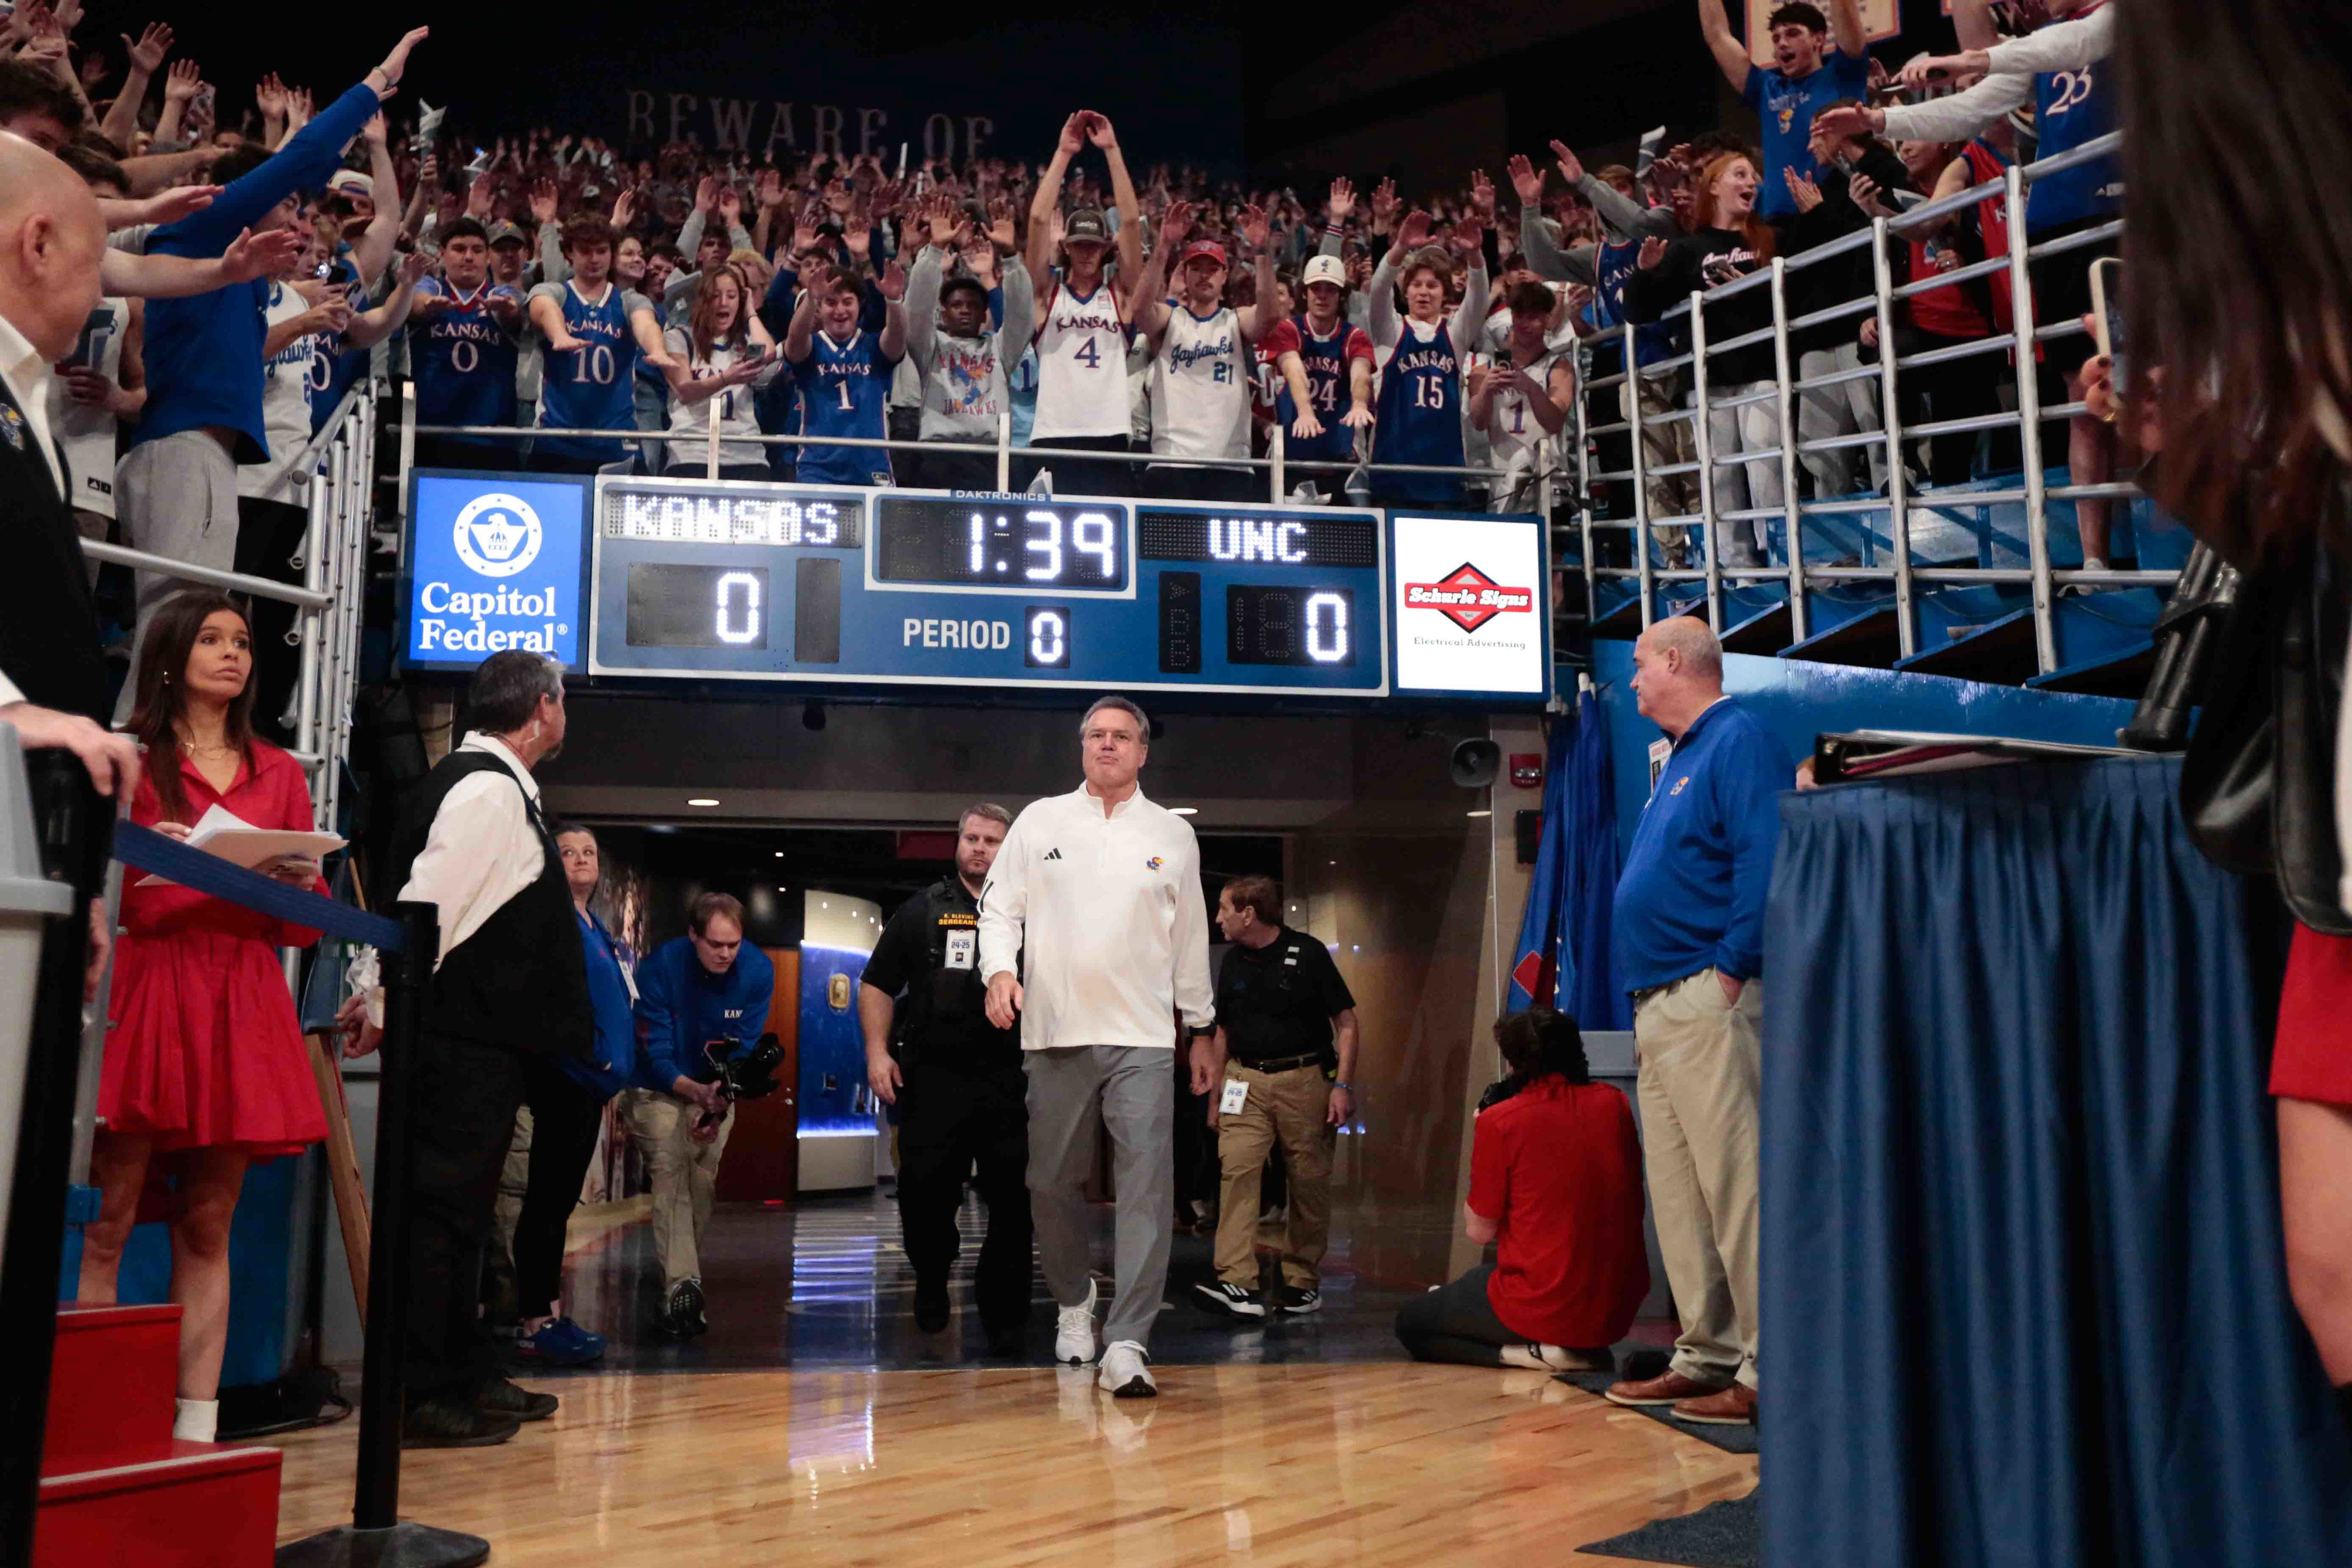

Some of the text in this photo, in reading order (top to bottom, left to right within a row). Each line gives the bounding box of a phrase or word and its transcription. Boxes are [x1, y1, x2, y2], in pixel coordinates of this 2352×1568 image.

[626, 88, 994, 164] BEWARE OF
[430, 322, 501, 346] KANSAS
[1056, 315, 1120, 333] KANSAS
[451, 340, 479, 373] 0
[570, 345, 615, 384] 10
[1074, 336, 1101, 369] 4
[1170, 336, 1234, 374] Jayhawks
[1397, 350, 1454, 374] KANSAS
[835, 379, 855, 410] 1
[1414, 375, 1444, 409] 15
[1508, 399, 1526, 434] 1
[956, 490, 1046, 502] DAKTRONICS
[625, 495, 838, 544] KANSAS
[969, 511, 1114, 580] 1:39
[1209, 518, 1307, 562] UNC
[421, 582, 556, 621] Capitol
[716, 572, 760, 644] 0
[1408, 586, 1529, 610] Schurle Signs
[903, 618, 1010, 650] PERIOD
[1031, 611, 1064, 663] 0
[1306, 593, 1348, 663] 0
[1414, 637, 1526, 650] Electrical Advertising
